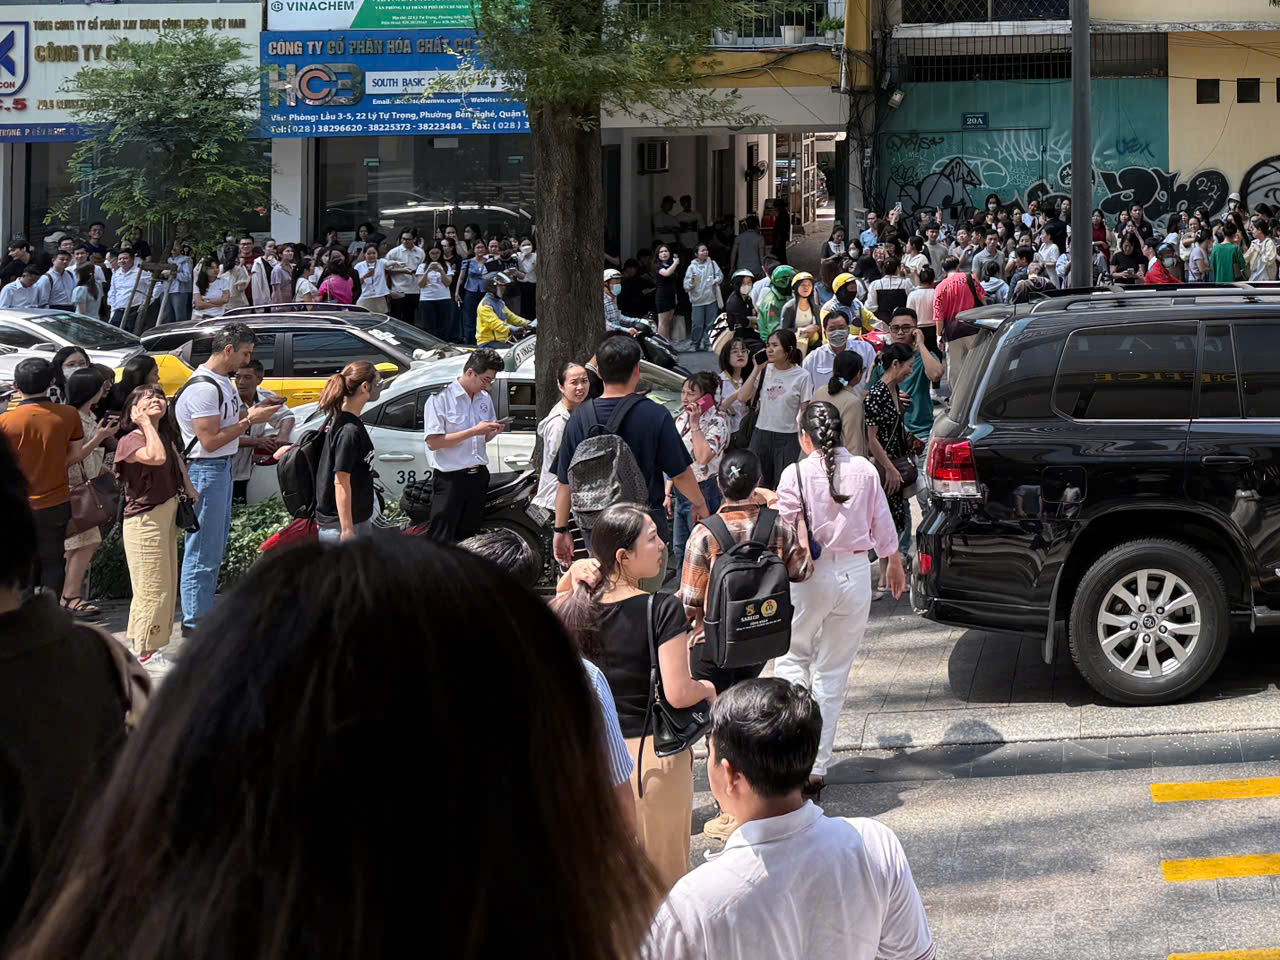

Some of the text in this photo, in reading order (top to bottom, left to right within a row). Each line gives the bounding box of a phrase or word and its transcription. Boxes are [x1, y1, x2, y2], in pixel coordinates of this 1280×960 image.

[286, 1, 355, 12] VINACHEM
[77, 20, 87, 30] TY
[228, 18, 246, 29] NAM
[268, 39, 303, 56] CÔNG
[307, 41, 323, 55] TY
[327, 36, 345, 55] CỔ
[349, 36, 384, 54] PHẦN
[387, 36, 412, 54] HÓA
[416, 35, 450, 54] CHẤT
[34, 41, 79, 63] CÔNG
[81, 44, 103, 62] TY
[372, 78, 399, 88] SOUTH
[402, 77, 425, 87] BASIC
[289, 112, 319, 122] Phòng:
[320, 111, 336, 121] Lầu
[337, 112, 354, 122] 3-5,
[356, 112, 367, 120] 22
[368, 112, 378, 122] Lý
[379, 111, 391, 122] Tự
[391, 111, 419, 121] Trọng,
[420, 110, 452, 121] Phường
[499, 110, 521, 120] Quận
[966, 117, 984, 125] 20A
[317, 123, 362, 133] 38296620
[368, 122, 411, 132] 38225373
[417, 122, 462, 131] 38223484
[498, 122, 515, 130] 028
[396, 470, 417, 485] 38
